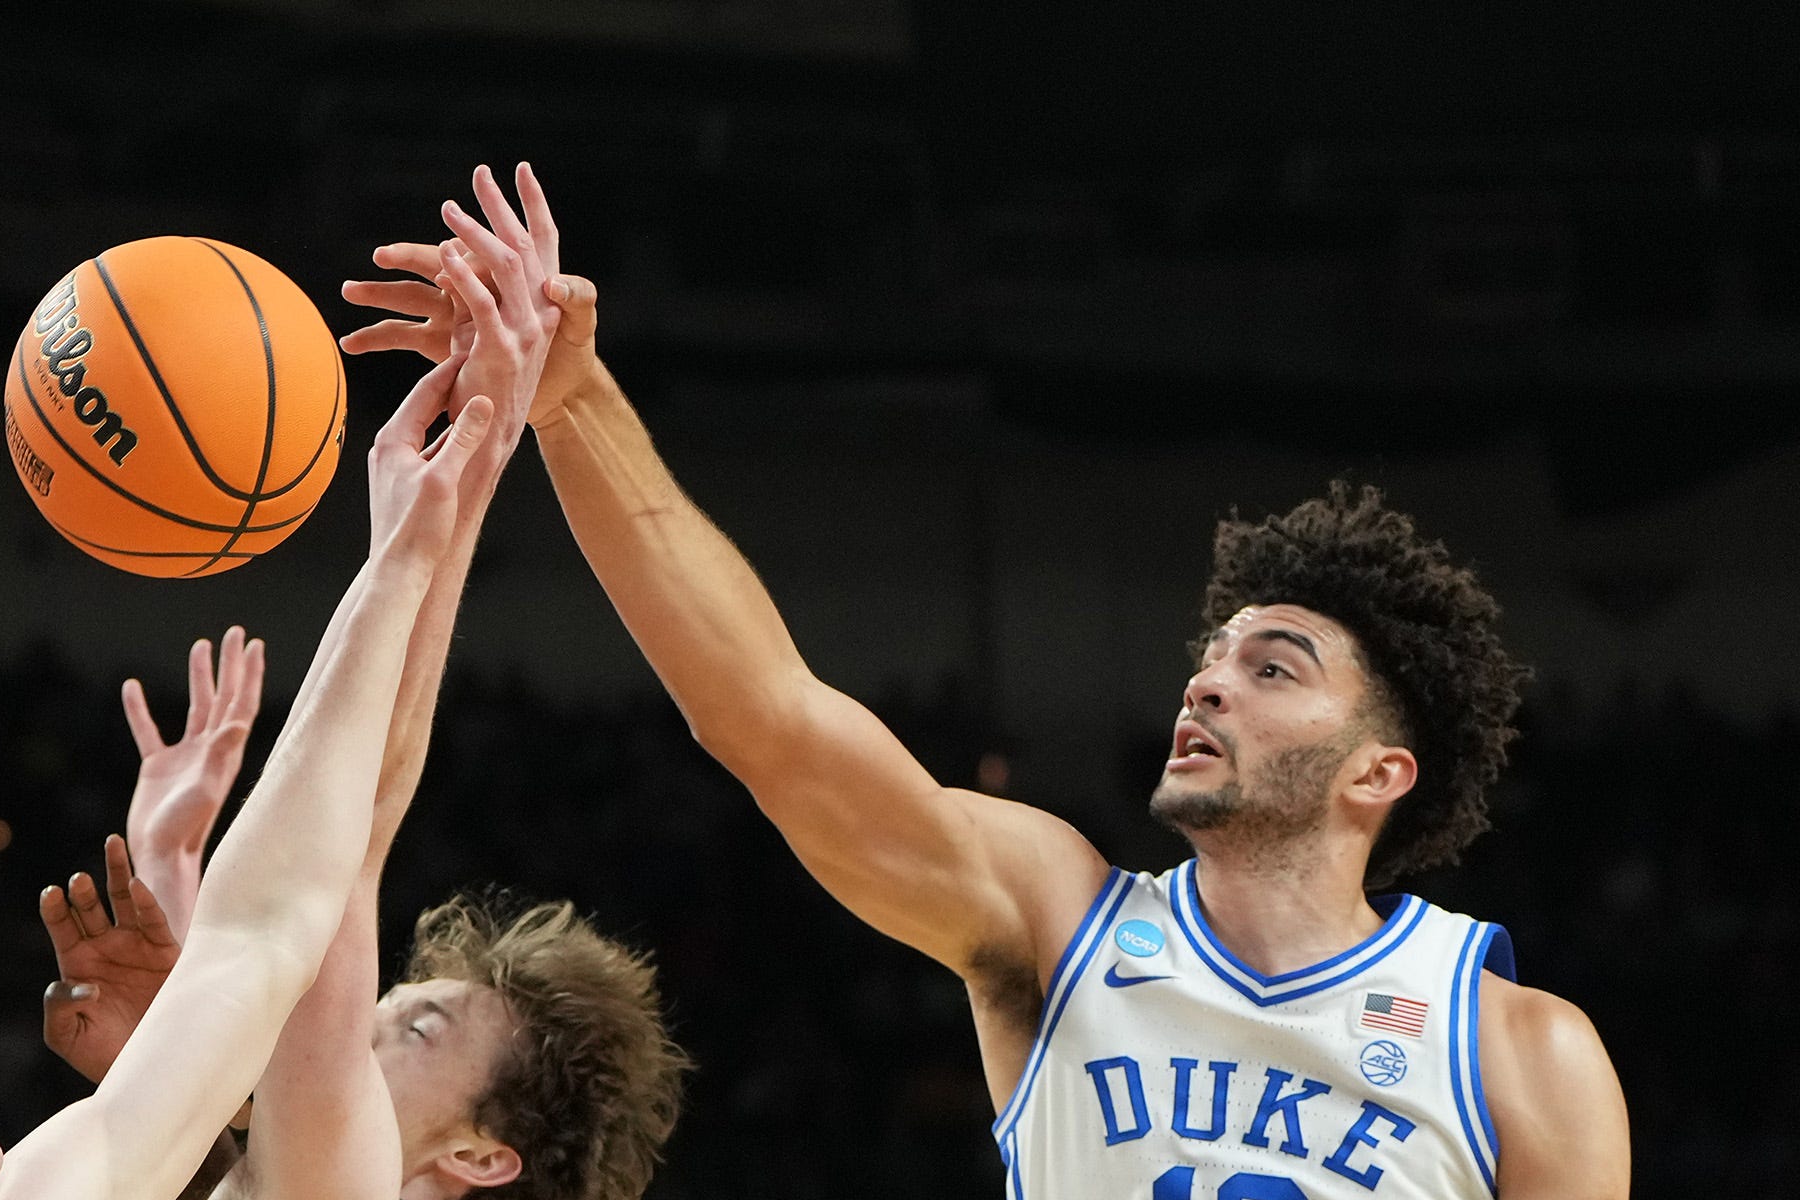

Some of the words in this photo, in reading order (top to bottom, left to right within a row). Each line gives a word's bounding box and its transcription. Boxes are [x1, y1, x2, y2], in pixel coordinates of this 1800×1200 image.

[33, 270, 139, 468] Wilson
[1120, 930, 1160, 953] NCAA
[1366, 1054, 1407, 1071] ACC
[1085, 1056, 1416, 1191] DUKE
